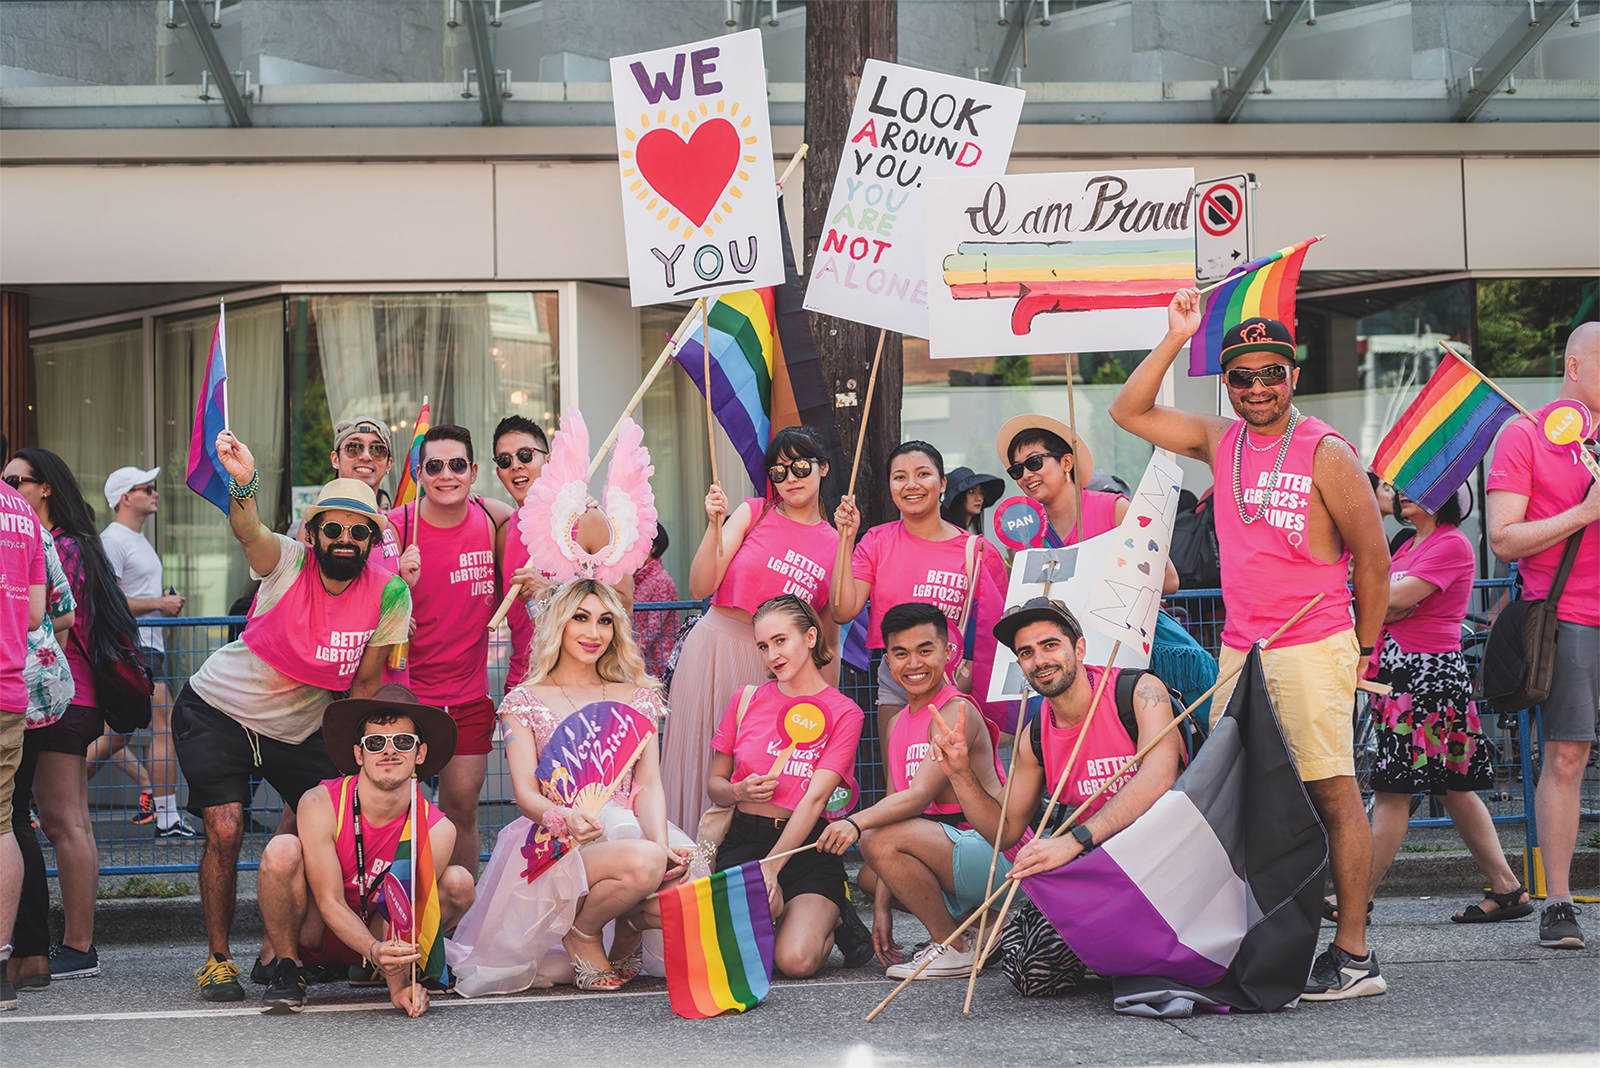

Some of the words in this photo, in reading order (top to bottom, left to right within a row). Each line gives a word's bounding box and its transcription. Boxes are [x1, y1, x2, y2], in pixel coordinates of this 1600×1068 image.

[629, 47, 723, 104] WE
[868, 75, 992, 137] LOOK
[851, 118, 982, 167] AROUND
[854, 149, 921, 188] YOU.
[846, 177, 910, 212] YOU
[964, 182, 1008, 235] I
[1012, 201, 1080, 234] am
[1078, 176, 1195, 232] Proud
[832, 203, 897, 237] ARE
[823, 228, 892, 263] NOT
[650, 236, 758, 288] YOU
[816, 256, 927, 305] ALONE
[1551, 411, 1575, 440] ALLY
[0, 493, 32, 516] NITY
[1244, 488, 1308, 509] LGBQ2S+
[0, 512, 35, 538] NTEER
[1007, 514, 1034, 531] PAN
[1264, 509, 1305, 531] LIVES
[0, 538, 26, 549] nity.ca
[459, 550, 494, 567] BETTER
[784, 549, 826, 581] BETTER
[450, 567, 494, 584] LGBTQ2S+
[767, 556, 818, 590] LGBTQ2S+
[926, 570, 968, 590] BETTER
[471, 580, 495, 596] LIVES
[913, 584, 964, 603] LGBTQ2S+
[791, 713, 818, 731] GAY
[783, 760, 814, 779] LIVES
